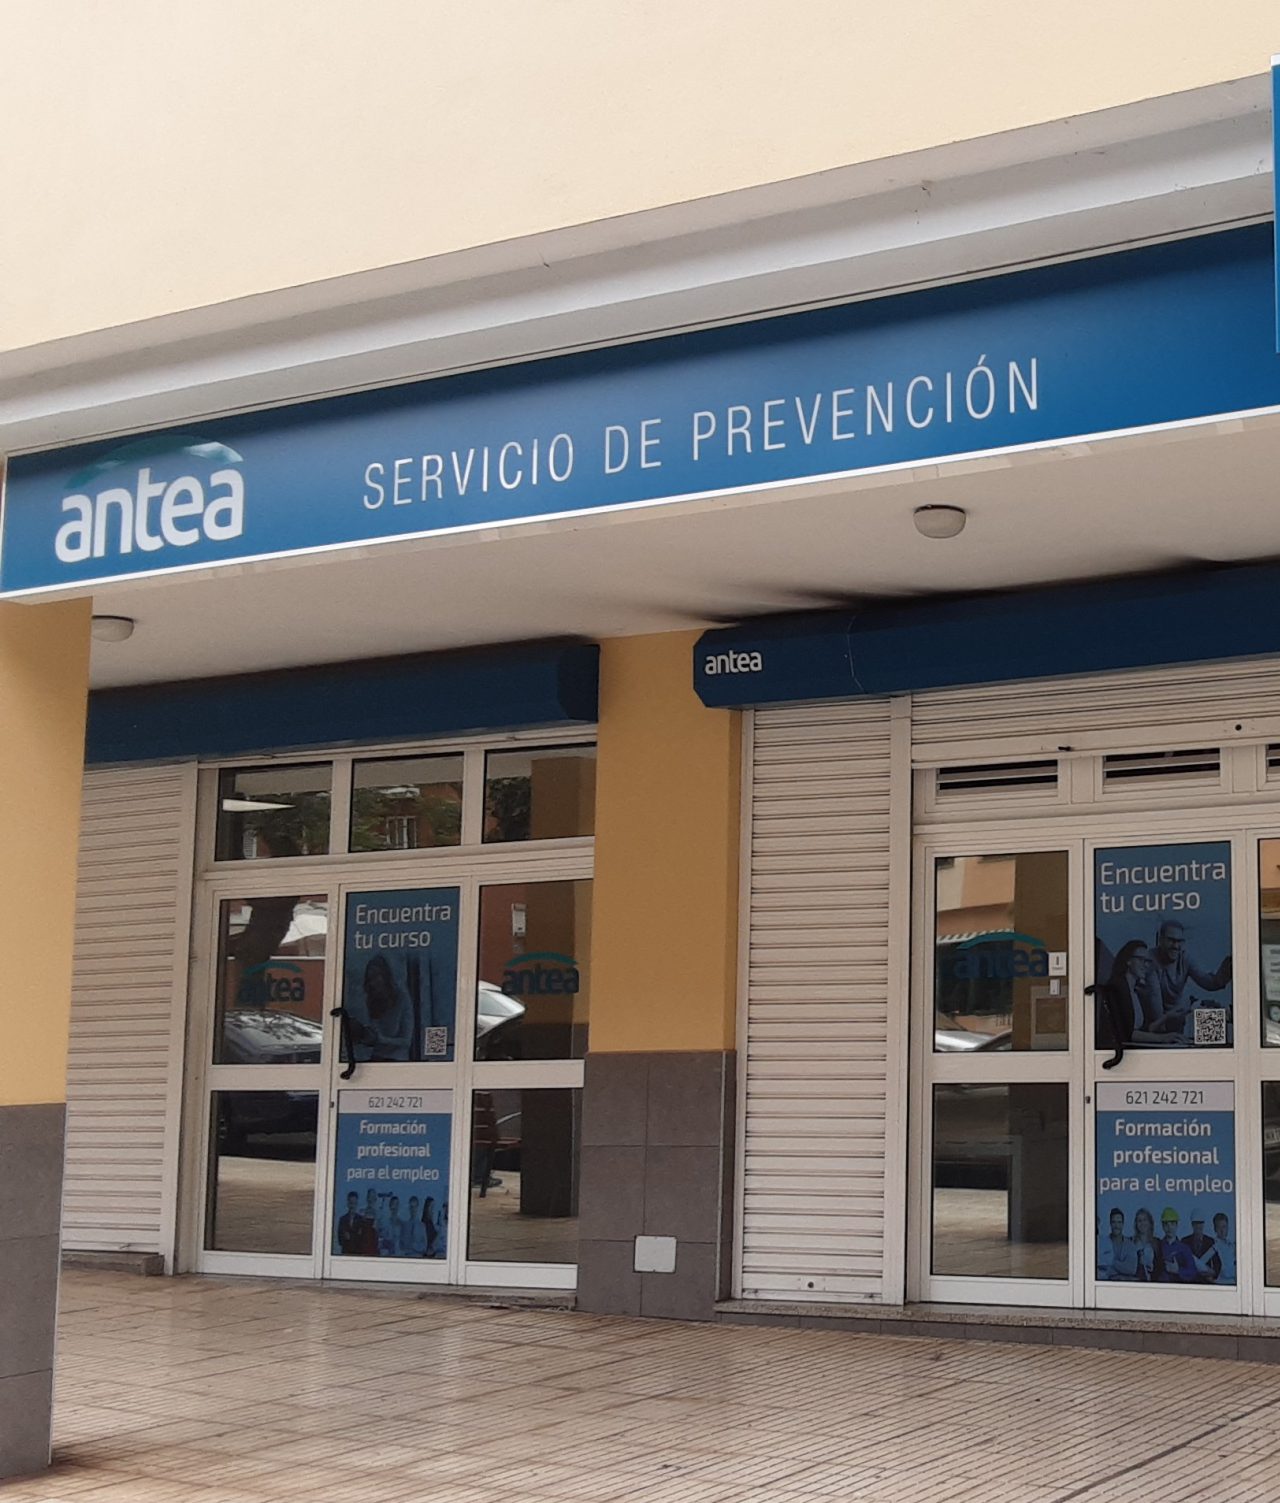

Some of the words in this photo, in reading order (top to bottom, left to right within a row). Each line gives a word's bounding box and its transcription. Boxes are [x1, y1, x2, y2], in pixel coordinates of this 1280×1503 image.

[363, 433, 575, 510] SERVICIO
[604, 418, 662, 474] DE
[692, 354, 1038, 461] PREVENCIÓN
[55, 467, 245, 564] antea
[704, 649, 763, 675] antea
[1101, 860, 1226, 886] Encuentra
[1100, 891, 1125, 913] tu
[1132, 892, 1201, 912] curso
[355, 903, 452, 925] Encuentra
[354, 930, 373, 949] tu
[378, 931, 431, 948] curso
[368, 1096, 385, 1108] 621
[386, 1096, 405, 1108] 242
[407, 1096, 423, 1108] 721
[1125, 1090, 1148, 1105] 621
[1152, 1090, 1179, 1105] 242
[1181, 1090, 1205, 1105] 721
[359, 1119, 427, 1135] Formación
[1114, 1118, 1212, 1137] Formación
[357, 1142, 431, 1160] profesional
[1113, 1146, 1220, 1168] profesional
[346, 1167, 376, 1182] para
[377, 1164, 390, 1180] el
[391, 1166, 440, 1184] empleo
[1099, 1177, 1140, 1195] para
[1144, 1173, 1161, 1192] el
[1164, 1174, 1233, 1196] empleo
